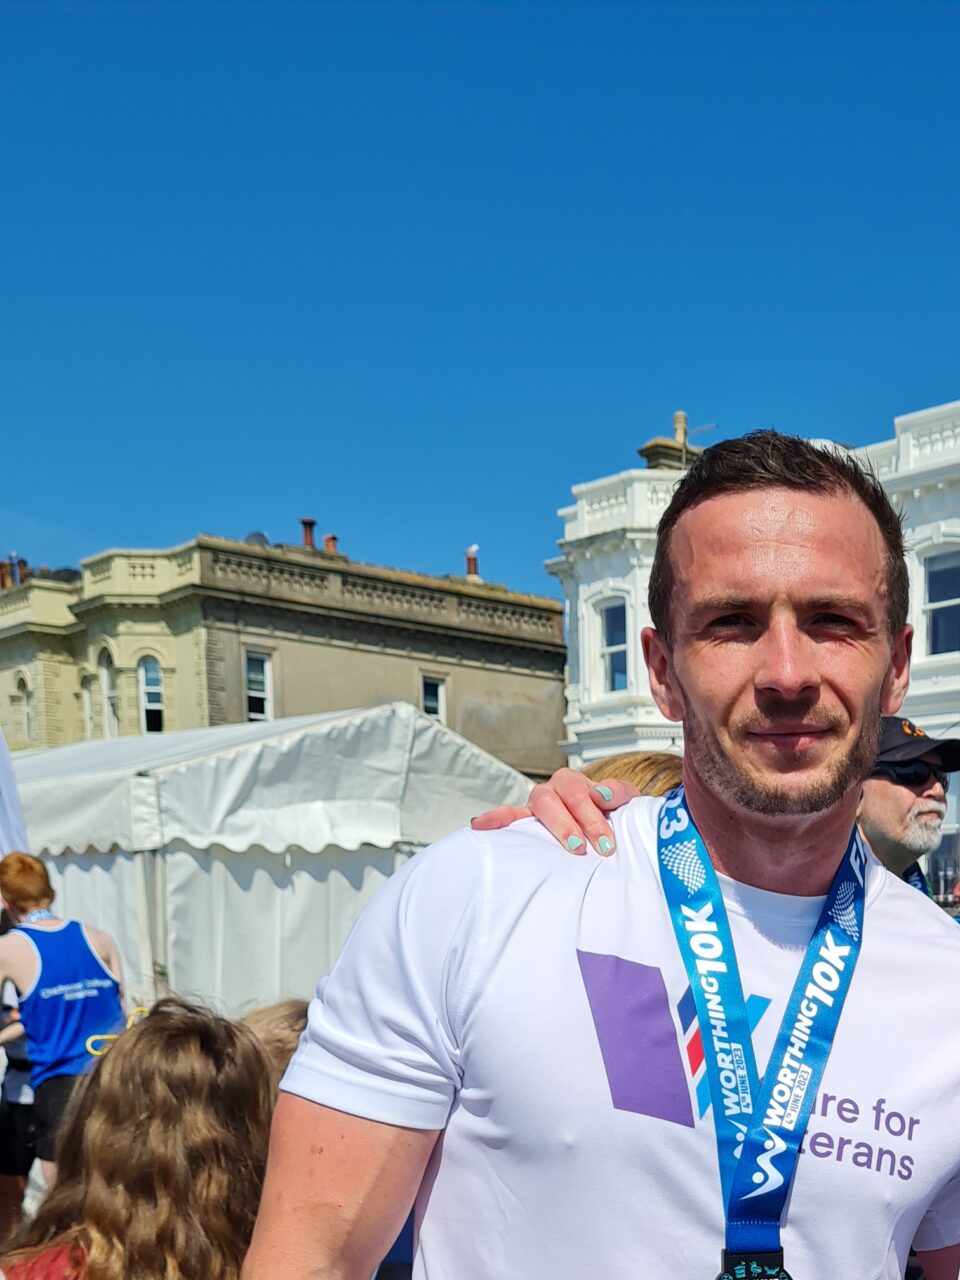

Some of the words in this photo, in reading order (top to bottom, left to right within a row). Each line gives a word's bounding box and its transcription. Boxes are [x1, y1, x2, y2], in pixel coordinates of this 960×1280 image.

[681, 902, 729, 975] 10K
[704, 972, 742, 1116] WORTHING
[763, 999, 818, 1127] WORTHING
[806, 930, 851, 1008] 10K
[733, 1047, 743, 1070] 2023
[797, 1069, 811, 1092] 2023
[873, 1098, 921, 1141] for
